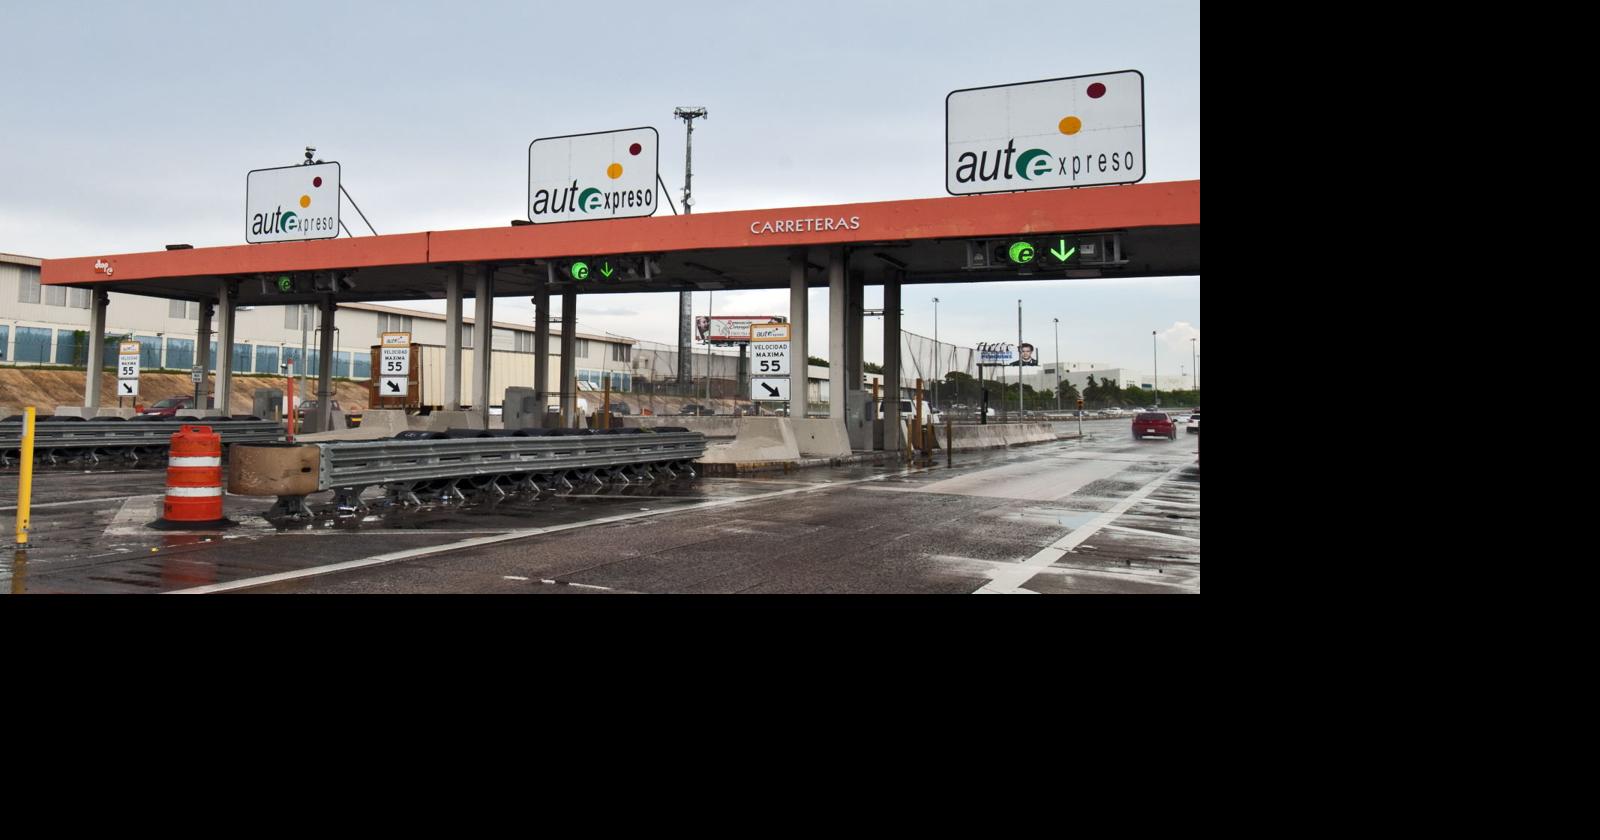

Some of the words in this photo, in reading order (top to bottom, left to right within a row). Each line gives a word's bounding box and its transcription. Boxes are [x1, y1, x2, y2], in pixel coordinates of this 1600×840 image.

[750, 216, 860, 234] CARRETERAS
[122, 366, 134, 375] 55
[387, 361, 402, 371] 55
[760, 360, 781, 372] 55
